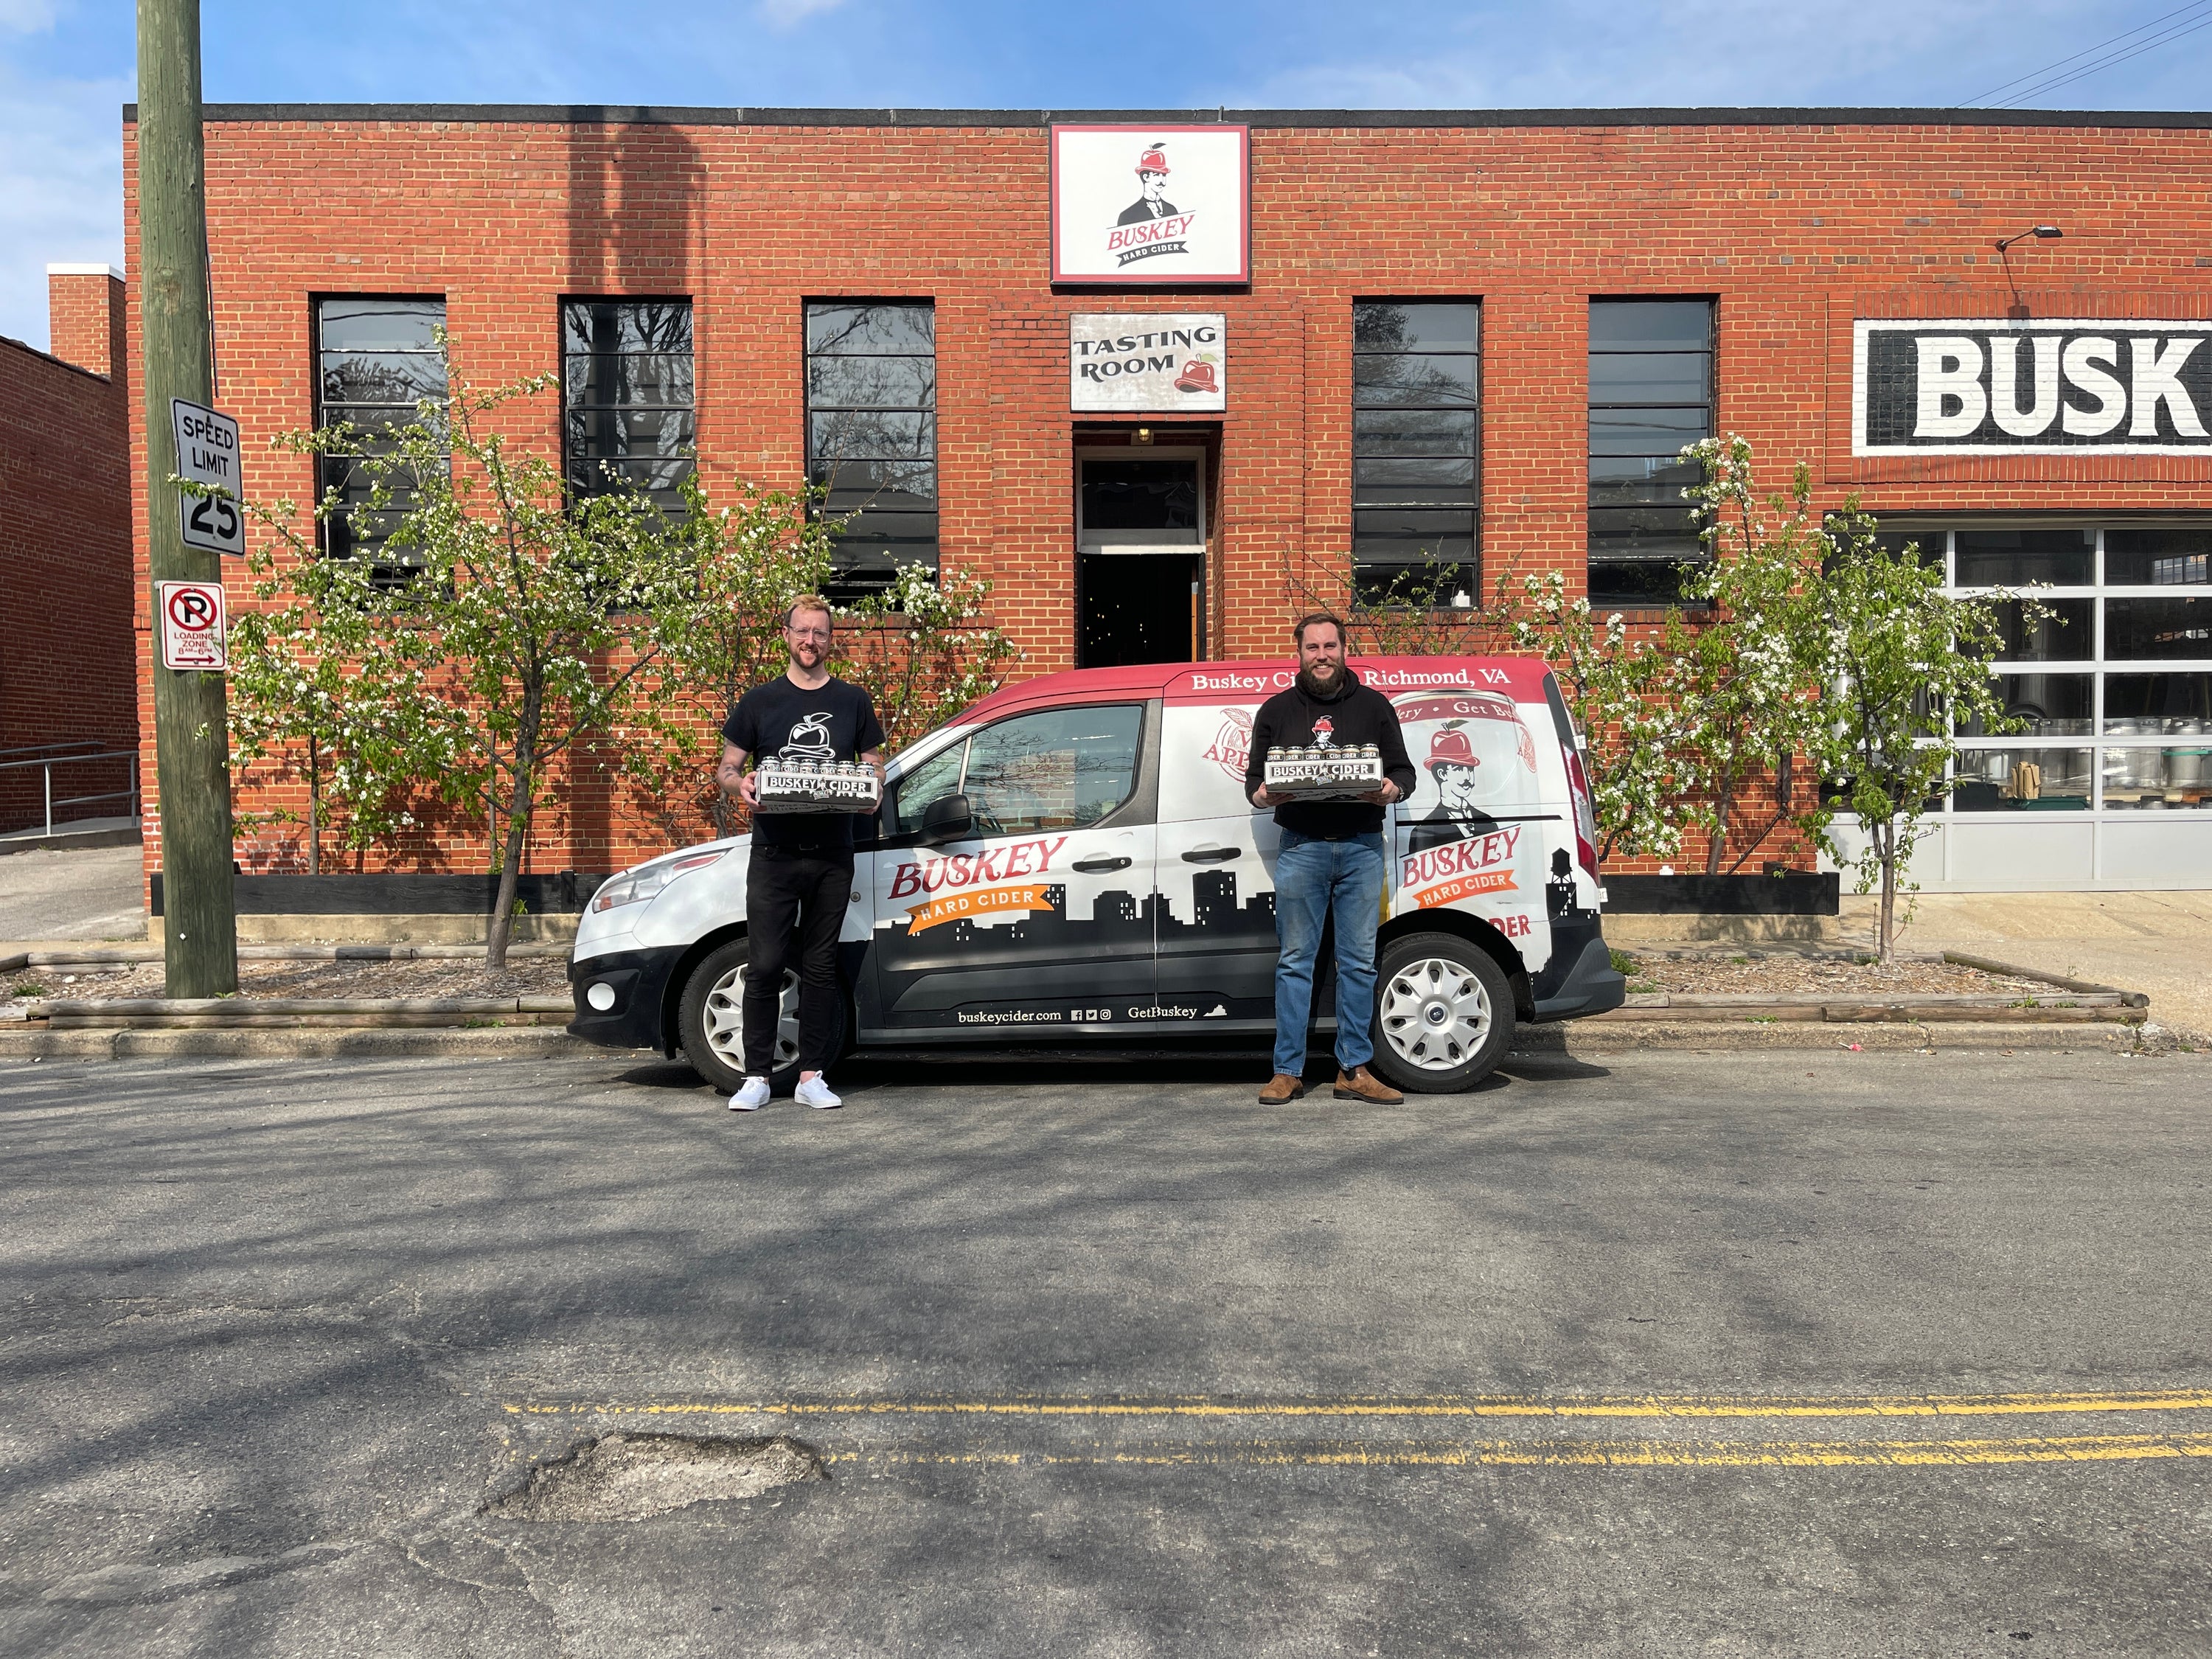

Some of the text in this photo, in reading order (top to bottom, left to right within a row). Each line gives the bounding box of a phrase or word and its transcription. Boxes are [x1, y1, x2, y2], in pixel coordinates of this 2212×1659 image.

[1107, 215, 1194, 251] BUSKEY
[1122, 242, 1180, 262] HARD CIDER
[1074, 327, 1217, 356] TASTING
[1080, 354, 1175, 383] ROOM
[1912, 335, 2211, 437] BUSK
[183, 415, 234, 451] SPEED
[192, 446, 229, 477] LIMIT
[190, 481, 237, 540] 25
[174, 632, 214, 640] LOADING
[1191, 672, 1268, 692] Buskey
[1363, 669, 1475, 687] Richmond,
[1478, 669, 1512, 684] VA
[1453, 701, 1488, 714] Get
[1202, 743, 1250, 768] APP
[1273, 764, 1368, 776] BUSKEY CIDER
[770, 777, 866, 792] BUSKEY CIDER
[887, 836, 1068, 900] BUSKEY
[1402, 827, 1521, 888] BUSKEY
[1422, 874, 1506, 906] HARD CIDER
[921, 891, 1034, 921] HARD CIDER
[1489, 914, 1531, 937] DER
[958, 1010, 1062, 1025] buskeycider.com
[1127, 1006, 1198, 1020] GetBuskey
